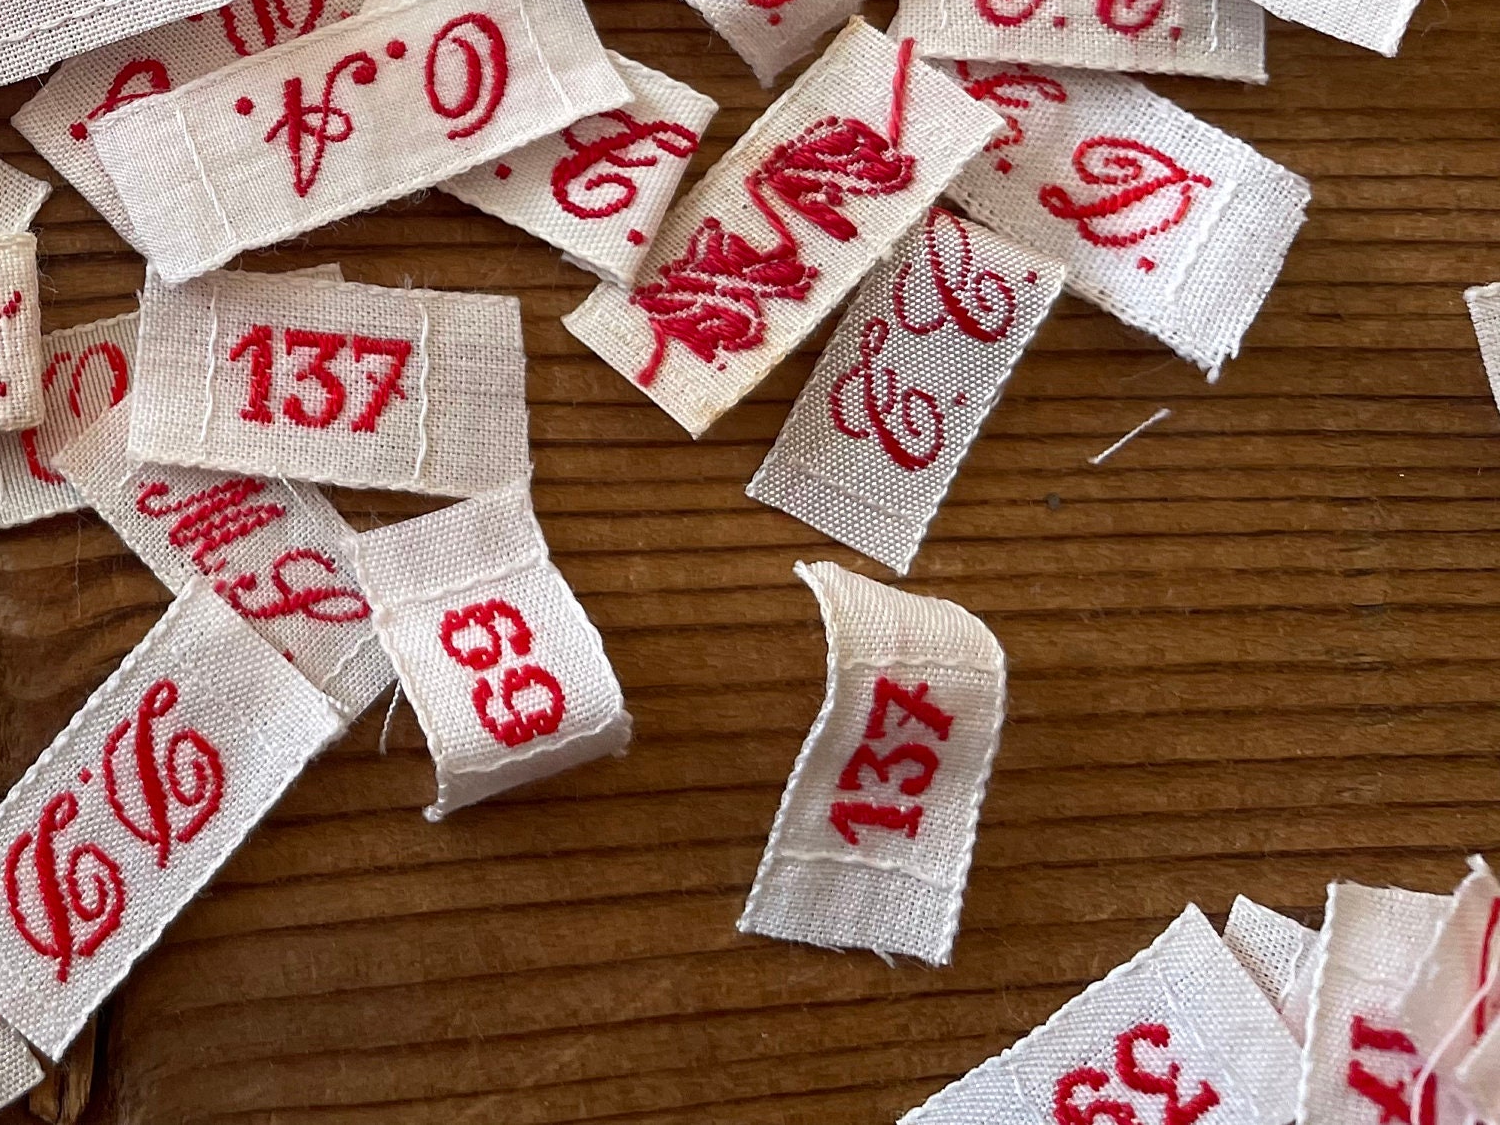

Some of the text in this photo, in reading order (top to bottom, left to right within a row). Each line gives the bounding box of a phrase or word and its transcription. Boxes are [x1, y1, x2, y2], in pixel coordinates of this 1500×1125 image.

[227, 322, 414, 435] 137
[437, 597, 568, 750] 69
[827, 674, 956, 847] 137
